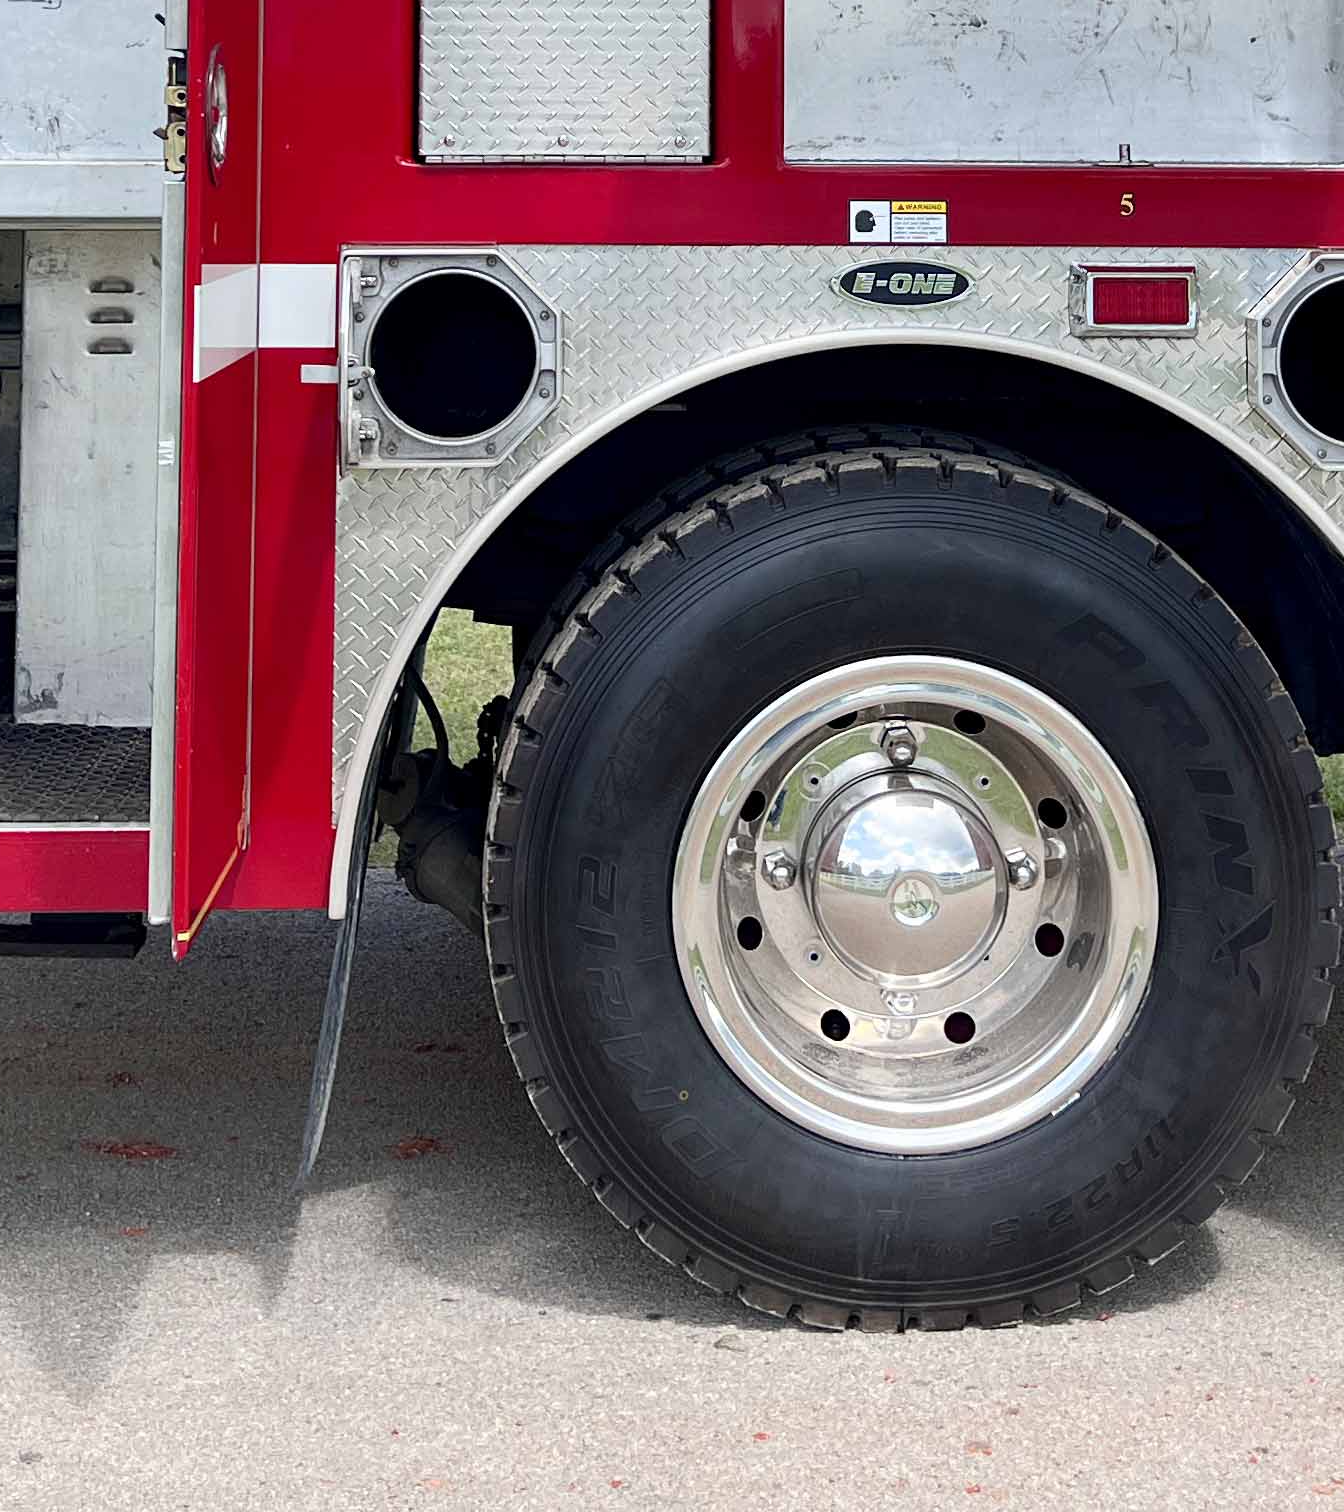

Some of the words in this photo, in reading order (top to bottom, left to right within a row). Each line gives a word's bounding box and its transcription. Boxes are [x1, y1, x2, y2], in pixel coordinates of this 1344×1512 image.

[905, 203, 942, 211] WARNING
[1120, 192, 1134, 216] 5
[852, 272, 957, 295] E-ONE
